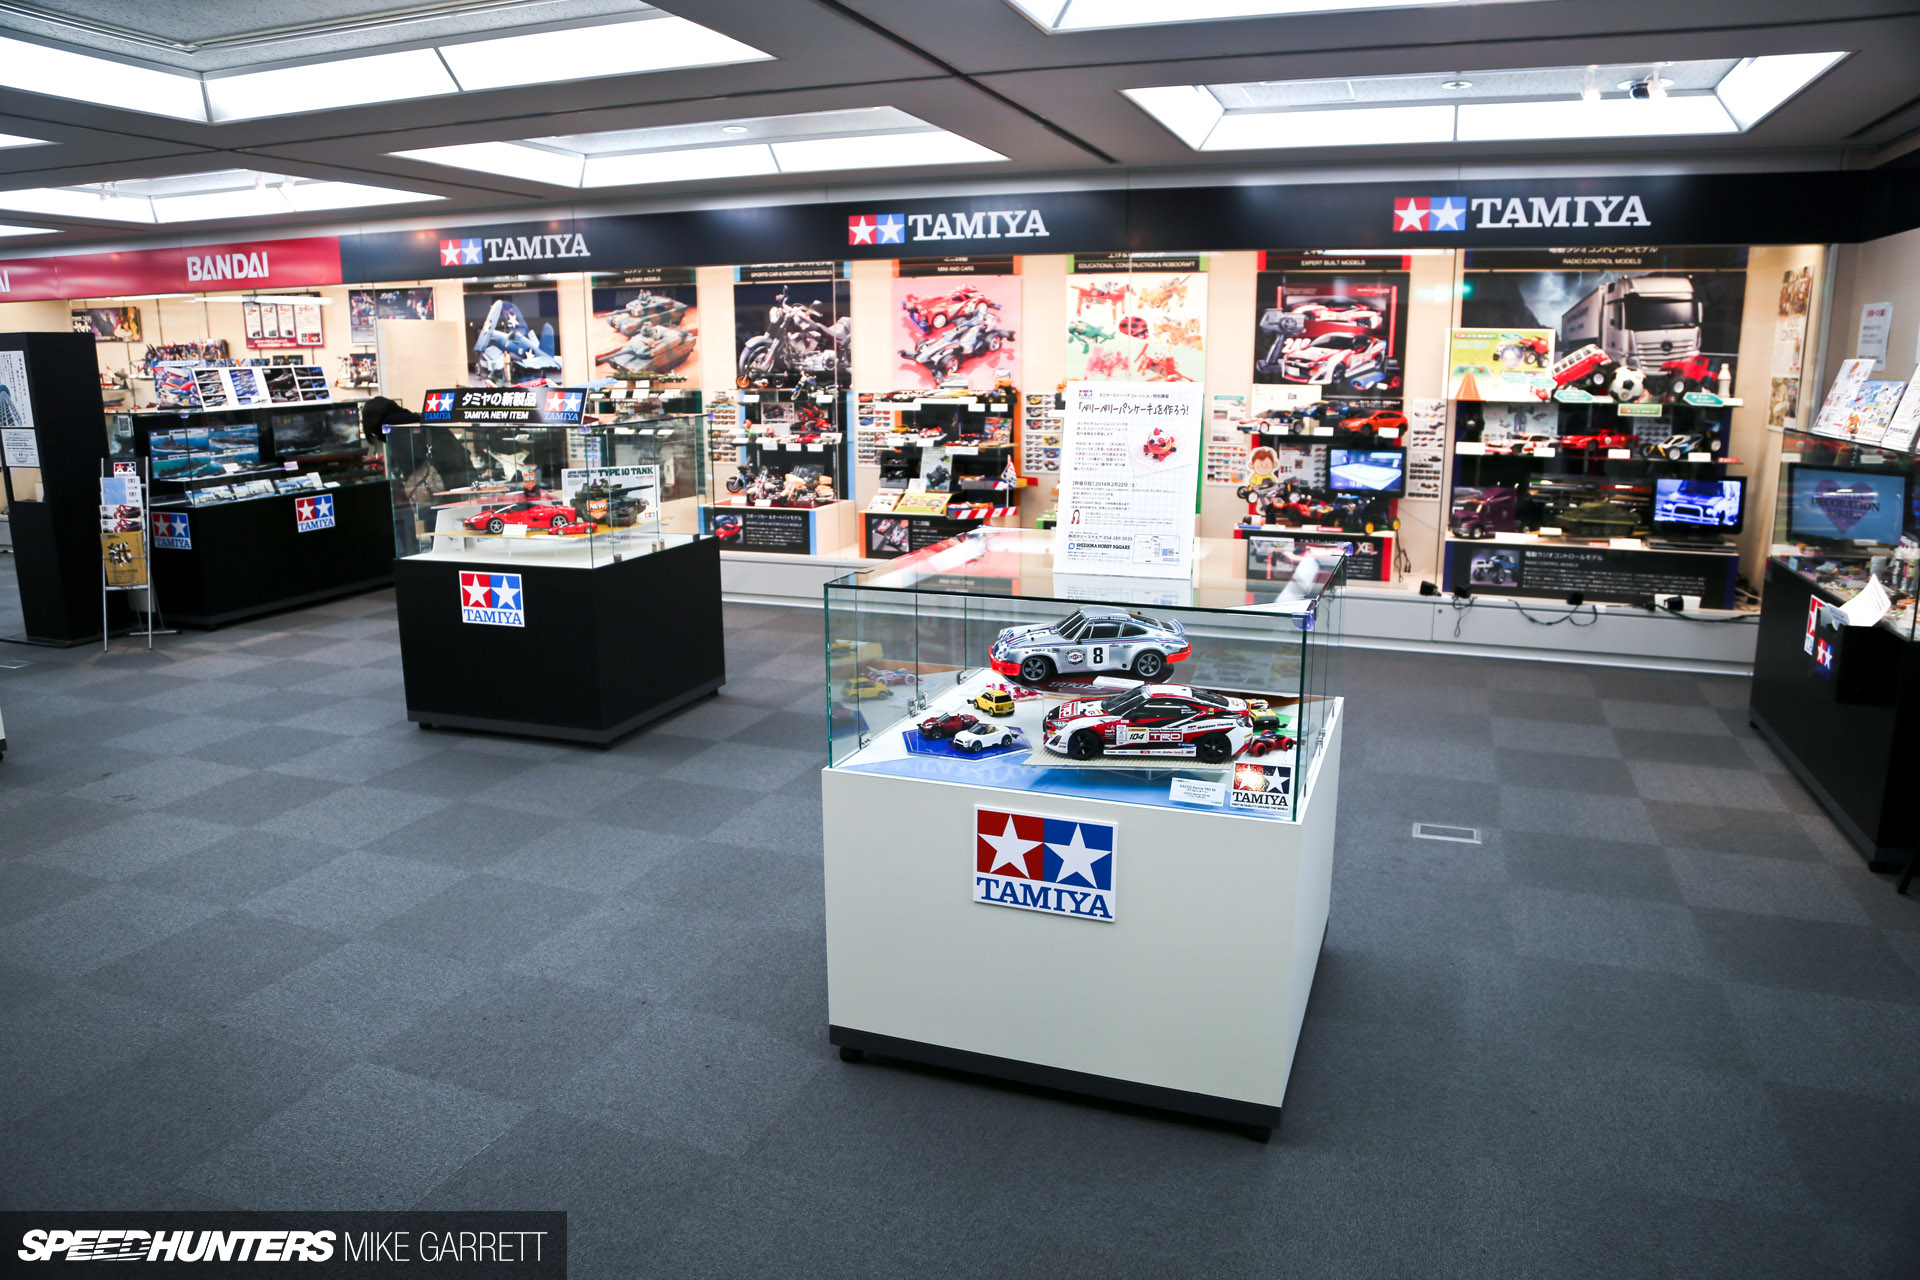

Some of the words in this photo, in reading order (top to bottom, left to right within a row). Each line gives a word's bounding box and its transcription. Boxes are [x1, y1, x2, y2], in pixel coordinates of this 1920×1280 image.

[1471, 195, 1652, 228] TAMIYA
[908, 209, 1050, 242] TAMIYA
[484, 233, 591, 262] TAMIYA
[186, 251, 270, 282] BANDAI
[462, 392, 537, 407] タミヤの新製品
[424, 412, 451, 421] TAMIYA
[463, 411, 490, 420] TAMIYA
[490, 411, 508, 420] NEW
[509, 411, 529, 420] ITEM
[543, 412, 579, 421] TAMIYA
[598, 468, 621, 477] TYPE
[621, 468, 630, 476] 10
[631, 467, 654, 475] TANK
[589, 502, 606, 510] NEW
[1811, 496, 1880, 512] DECORATION
[298, 518, 334, 532] TAMIYA
[155, 537, 191, 549] TAMIYA
[463, 608, 523, 625] TAMIYA
[1093, 647, 1104, 664] 8
[1150, 733, 1182, 742] TRD
[1232, 792, 1288, 806] TAMIYA
[977, 876, 1113, 919] TAMIYA
